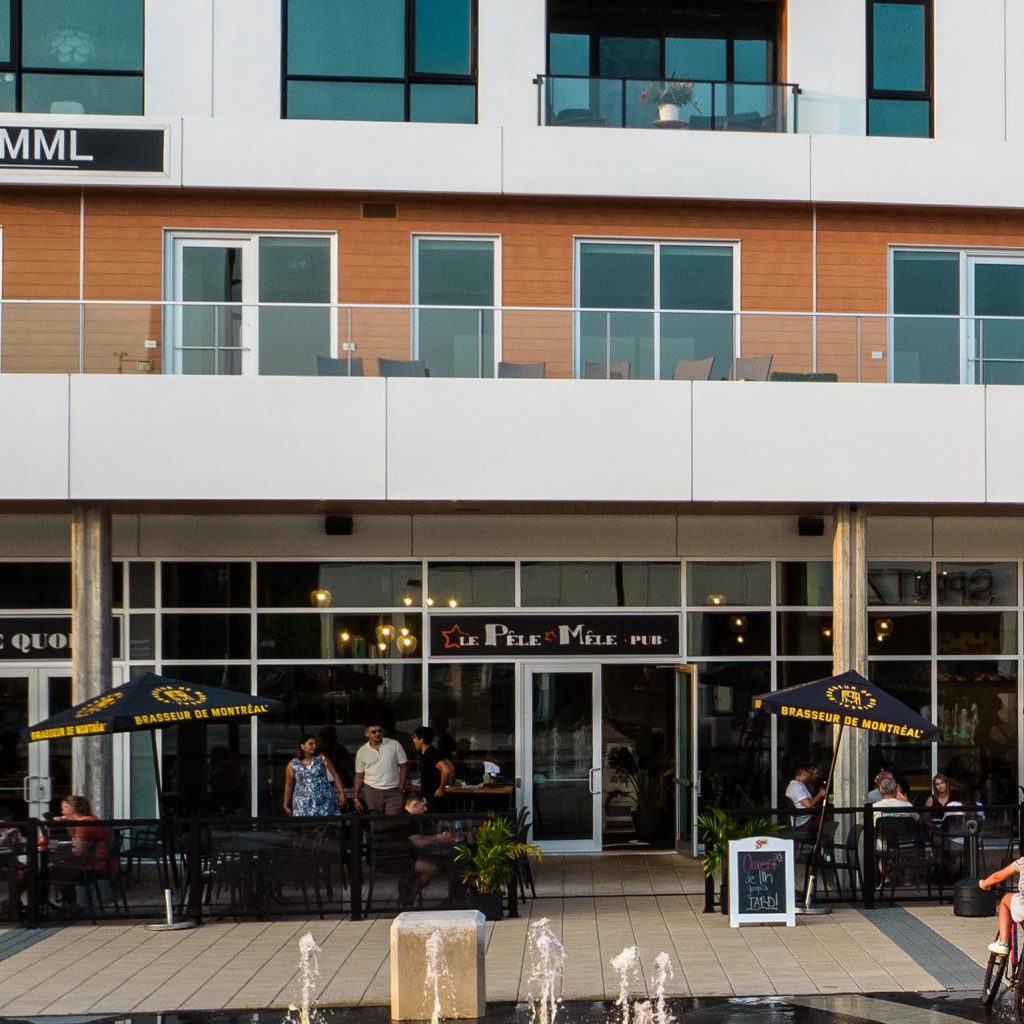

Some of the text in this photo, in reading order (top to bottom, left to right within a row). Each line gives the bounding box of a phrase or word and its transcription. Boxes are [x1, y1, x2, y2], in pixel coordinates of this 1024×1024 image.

[459, 634, 479, 646] LE
[630, 635, 663, 645] PUB
[134, 703, 267, 726] BRASSEUR DE MONTRÉAL
[781, 706, 921, 739] BRASSEUR DE MONTRÉAL
